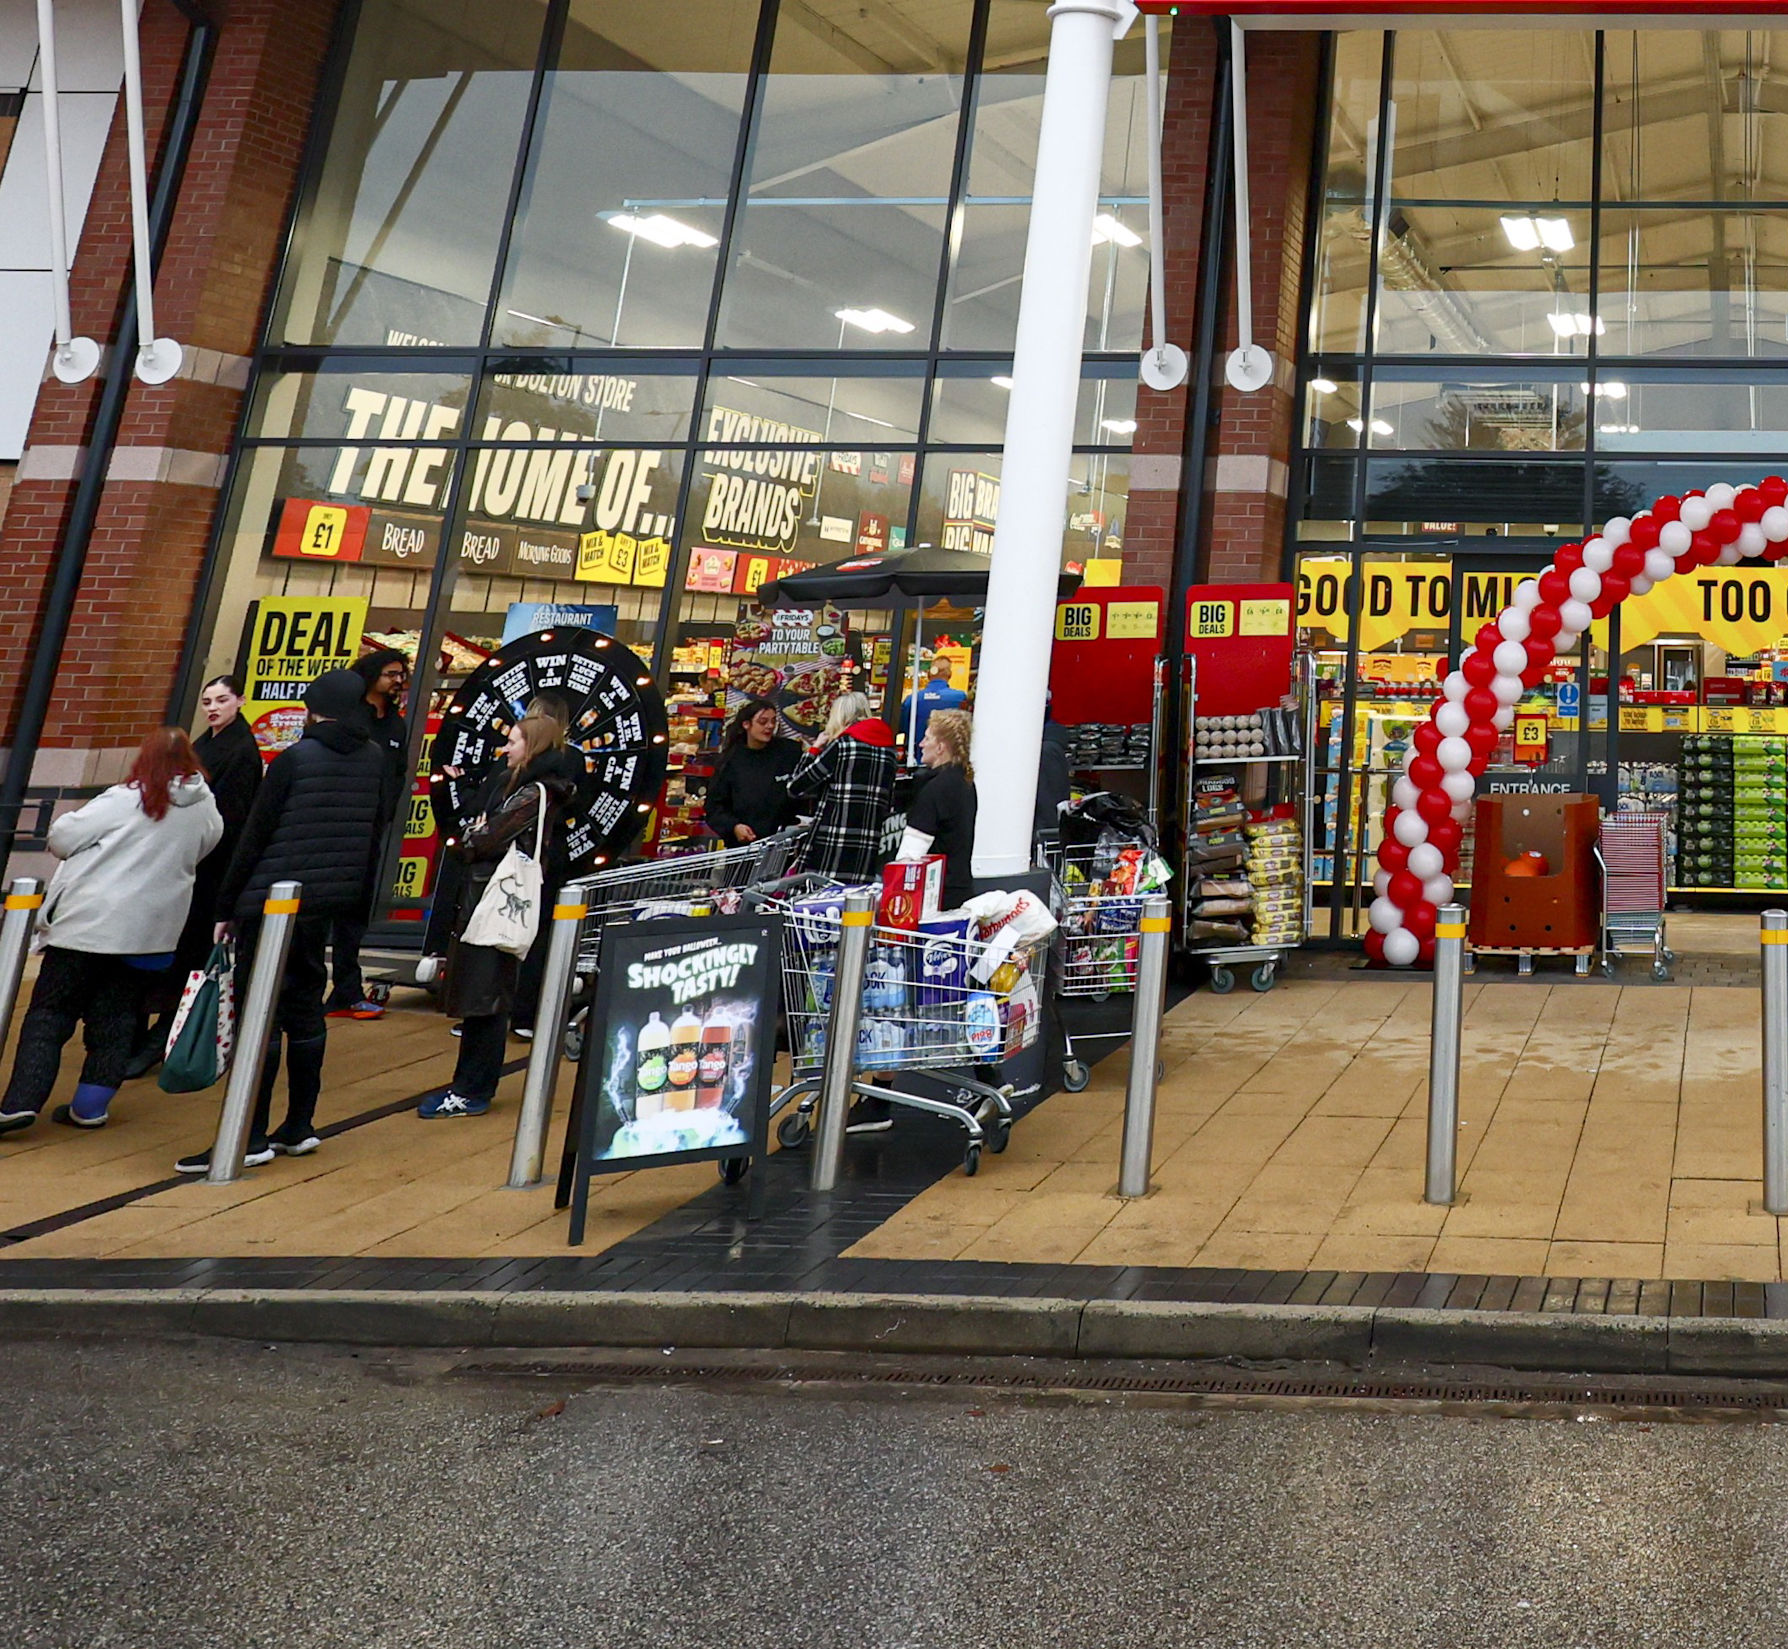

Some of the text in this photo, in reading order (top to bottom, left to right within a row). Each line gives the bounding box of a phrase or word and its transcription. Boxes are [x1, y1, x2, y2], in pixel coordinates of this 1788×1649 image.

[584, 375, 637, 412] STORE
[328, 387, 462, 507] THE
[948, 472, 975, 520] BIG
[706, 473, 801, 541] BRANDS
[312, 523, 334, 550] £1
[382, 523, 425, 558] BREAD
[461, 531, 500, 564] BREAD
[1406, 576, 1450, 617] TO
[1697, 580, 1771, 623] TOO
[533, 612, 593, 625] RESTAURANT
[780, 613, 810, 622] FRIDAYS
[1064, 607, 1091, 625] BIG
[1200, 604, 1225, 623] BIG
[259, 611, 352, 657] DEAL
[772, 629, 810, 641] TO YOUR
[1063, 627, 1091, 638] DEALS
[1198, 624, 1225, 635] DEALS
[759, 642, 819, 655] PARTY TABLE
[256, 659, 275, 676] OF
[277, 659, 304, 676] THE
[536, 654, 567, 668] WIN
[571, 654, 605, 673] BETTER
[492, 661, 527, 688] BETTER
[500, 671, 525, 691] LUCK
[546, 668, 555, 678] A
[570, 672, 594, 687] NEXT
[573, 664, 597, 679] LUCK
[261, 682, 296, 700] HALF
[503, 678, 527, 698] NEXT
[538, 677, 562, 688] CAN
[567, 679, 590, 695] TIME
[610, 675, 630, 701] WIN
[506, 685, 531, 704] TIME
[599, 692, 615, 710] CAN
[608, 691, 616, 700] A
[465, 692, 488, 719] WIN
[475, 698, 500, 732] BOTTLE
[615, 715, 627, 750] BOTTLE
[630, 712, 642, 742] WIN
[1523, 727, 1539, 741] £3
[451, 731, 469, 766] WIN
[472, 738, 485, 764] CAN
[603, 756, 617, 783] CAN
[619, 755, 638, 791] WIN
[1491, 782, 1571, 794] ENTRANCE
[408, 799, 429, 822] IG
[568, 840, 595, 862] WIN
[396, 862, 416, 884] IG
[627, 943, 758, 989] SHOCKINGLY
[671, 964, 742, 1005] TASTY!
[971, 1027, 993, 1042] Bold
[668, 1060, 698, 1073] Tango
[700, 1059, 726, 1072] Tango
